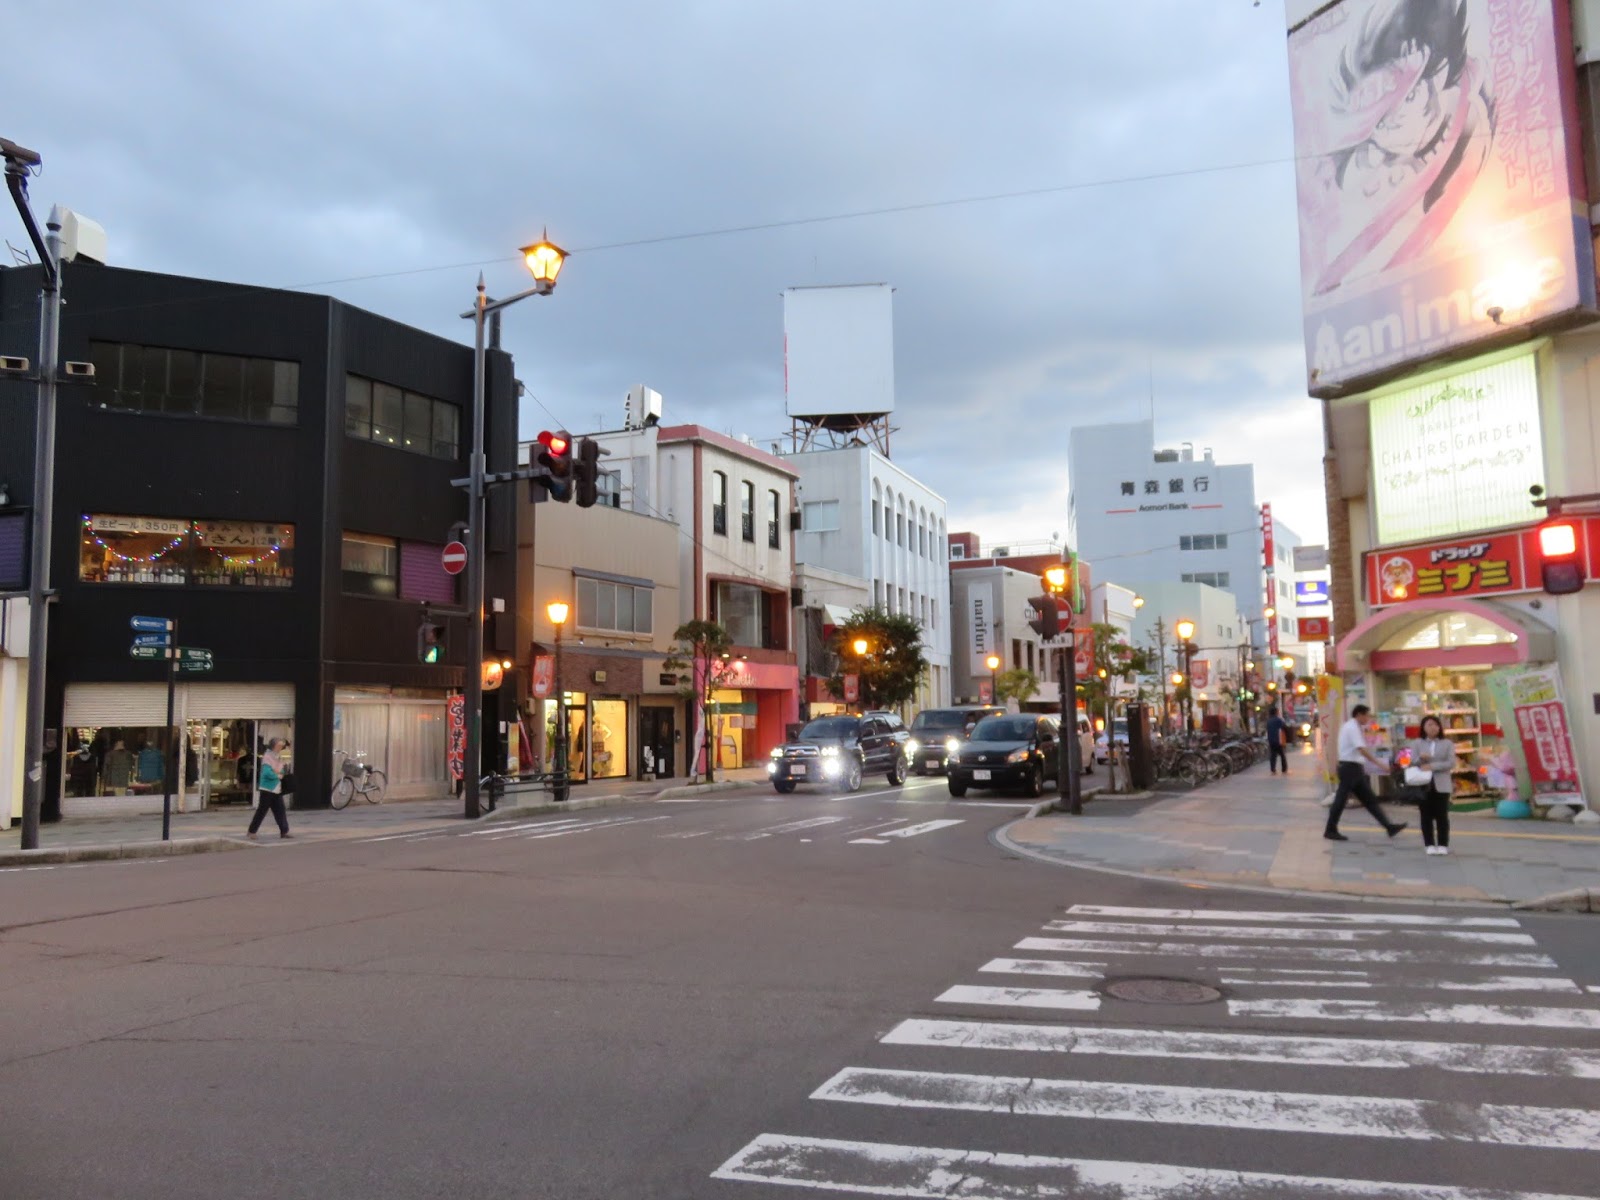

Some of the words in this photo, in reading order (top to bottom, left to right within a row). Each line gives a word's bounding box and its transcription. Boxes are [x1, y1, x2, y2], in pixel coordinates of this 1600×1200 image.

[1381, 440, 1448, 467] CHAIRS
[1454, 421, 1528, 449] GARDEN
[1120, 476, 1209, 496] 青森銀行
[1139, 504, 1167, 512] Aomori
[1168, 502, 1189, 510] Bank
[1430, 542, 1490, 563] ドラッグ
[1417, 560, 1510, 594] ミナミ
[974, 599, 988, 655] narifuri
